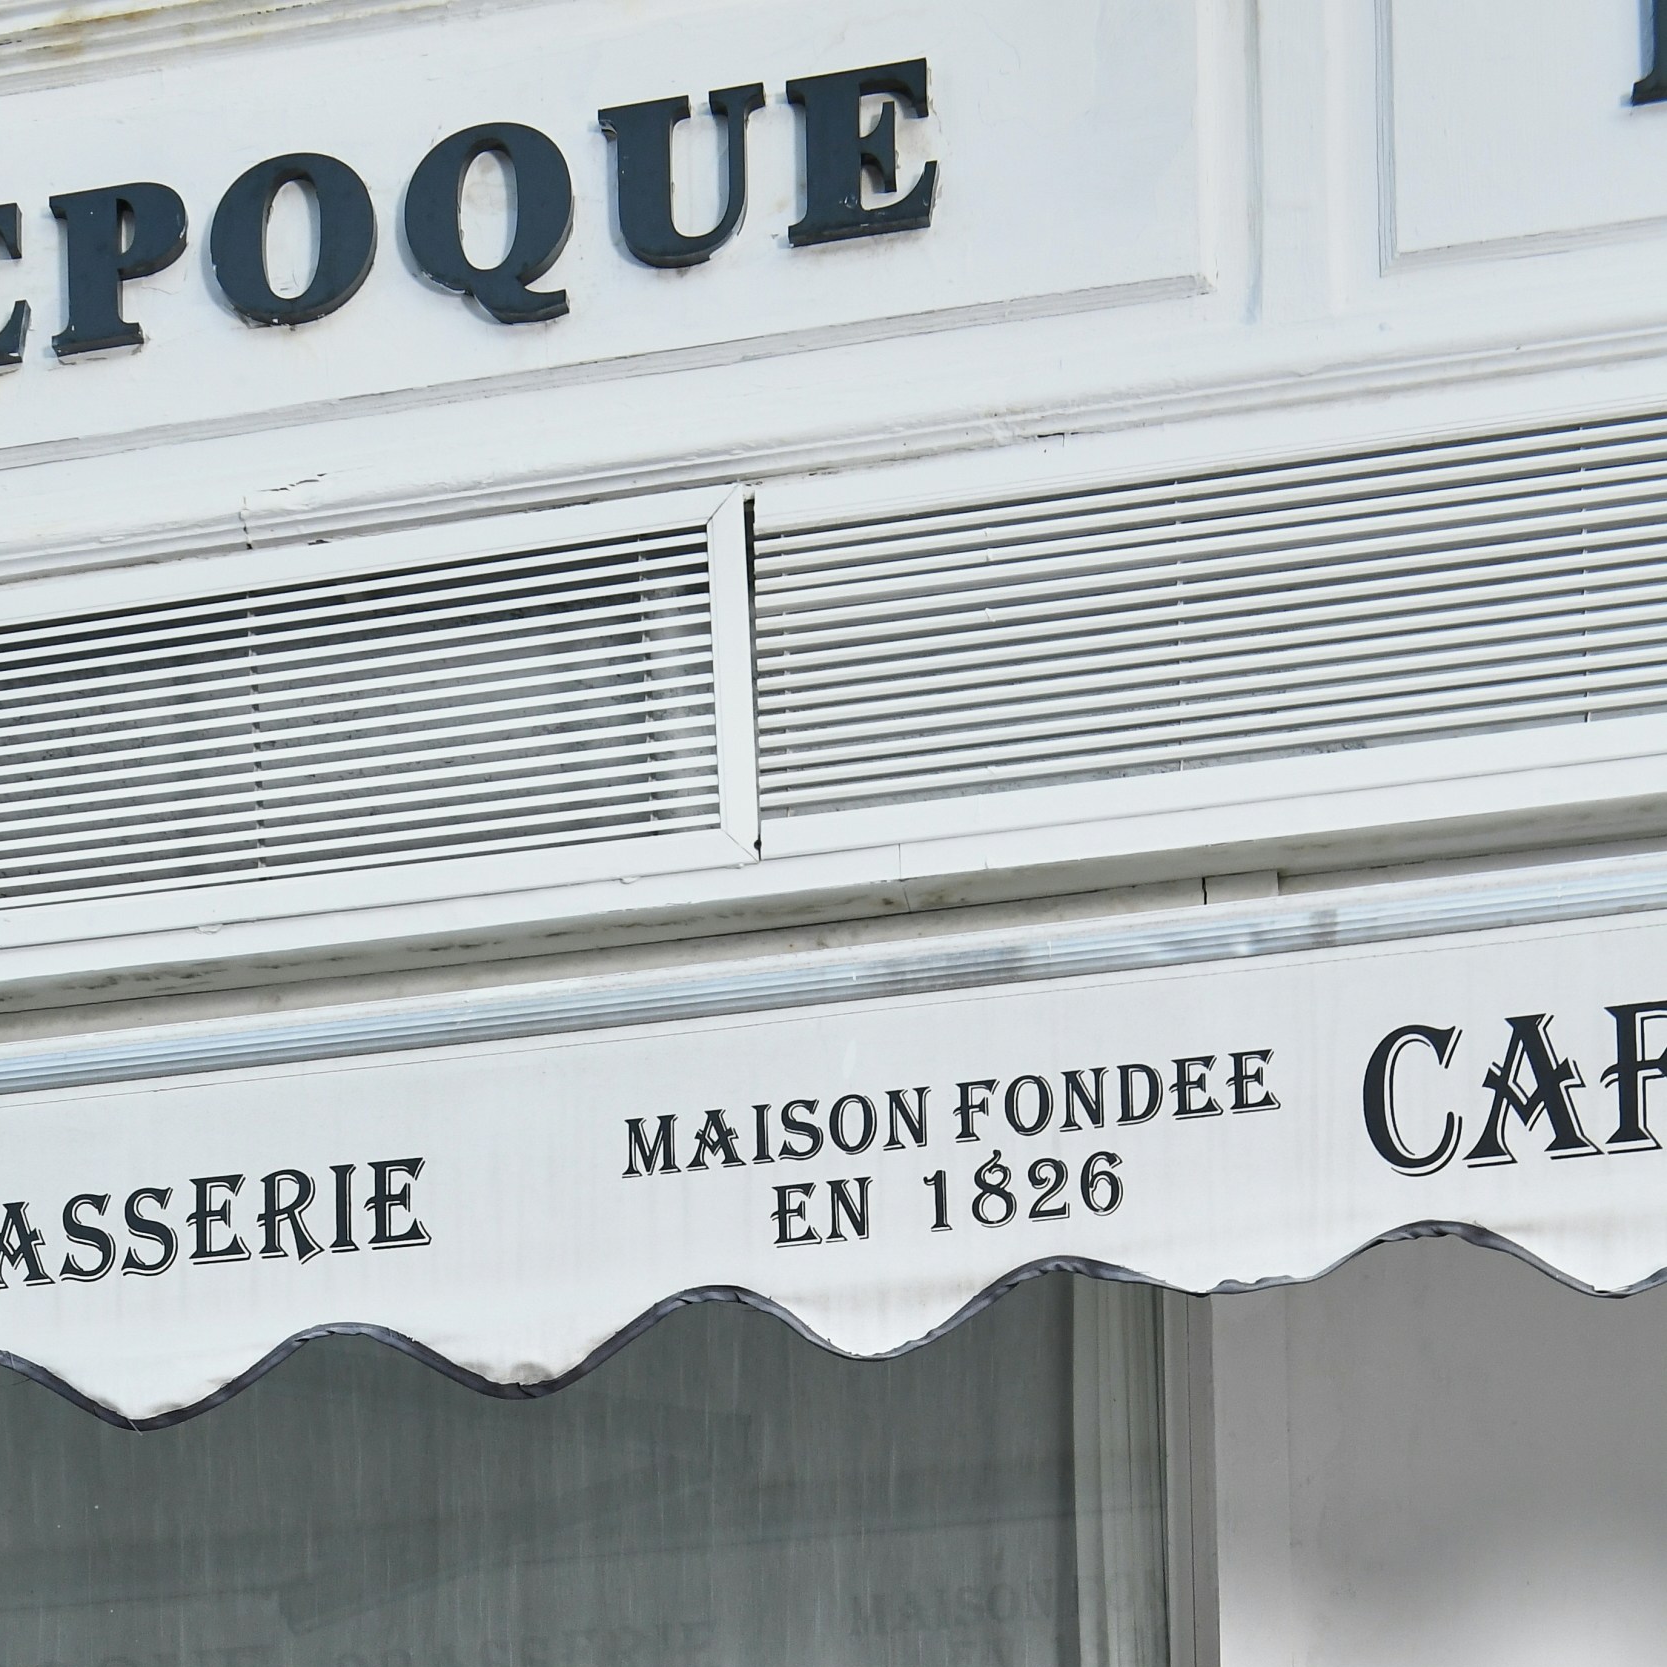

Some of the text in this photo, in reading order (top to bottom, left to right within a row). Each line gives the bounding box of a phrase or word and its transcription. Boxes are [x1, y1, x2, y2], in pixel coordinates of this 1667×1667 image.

[622, 1049, 1281, 1178] MAISON FONDEE
[771, 1150, 1123, 1248] EN 1826
